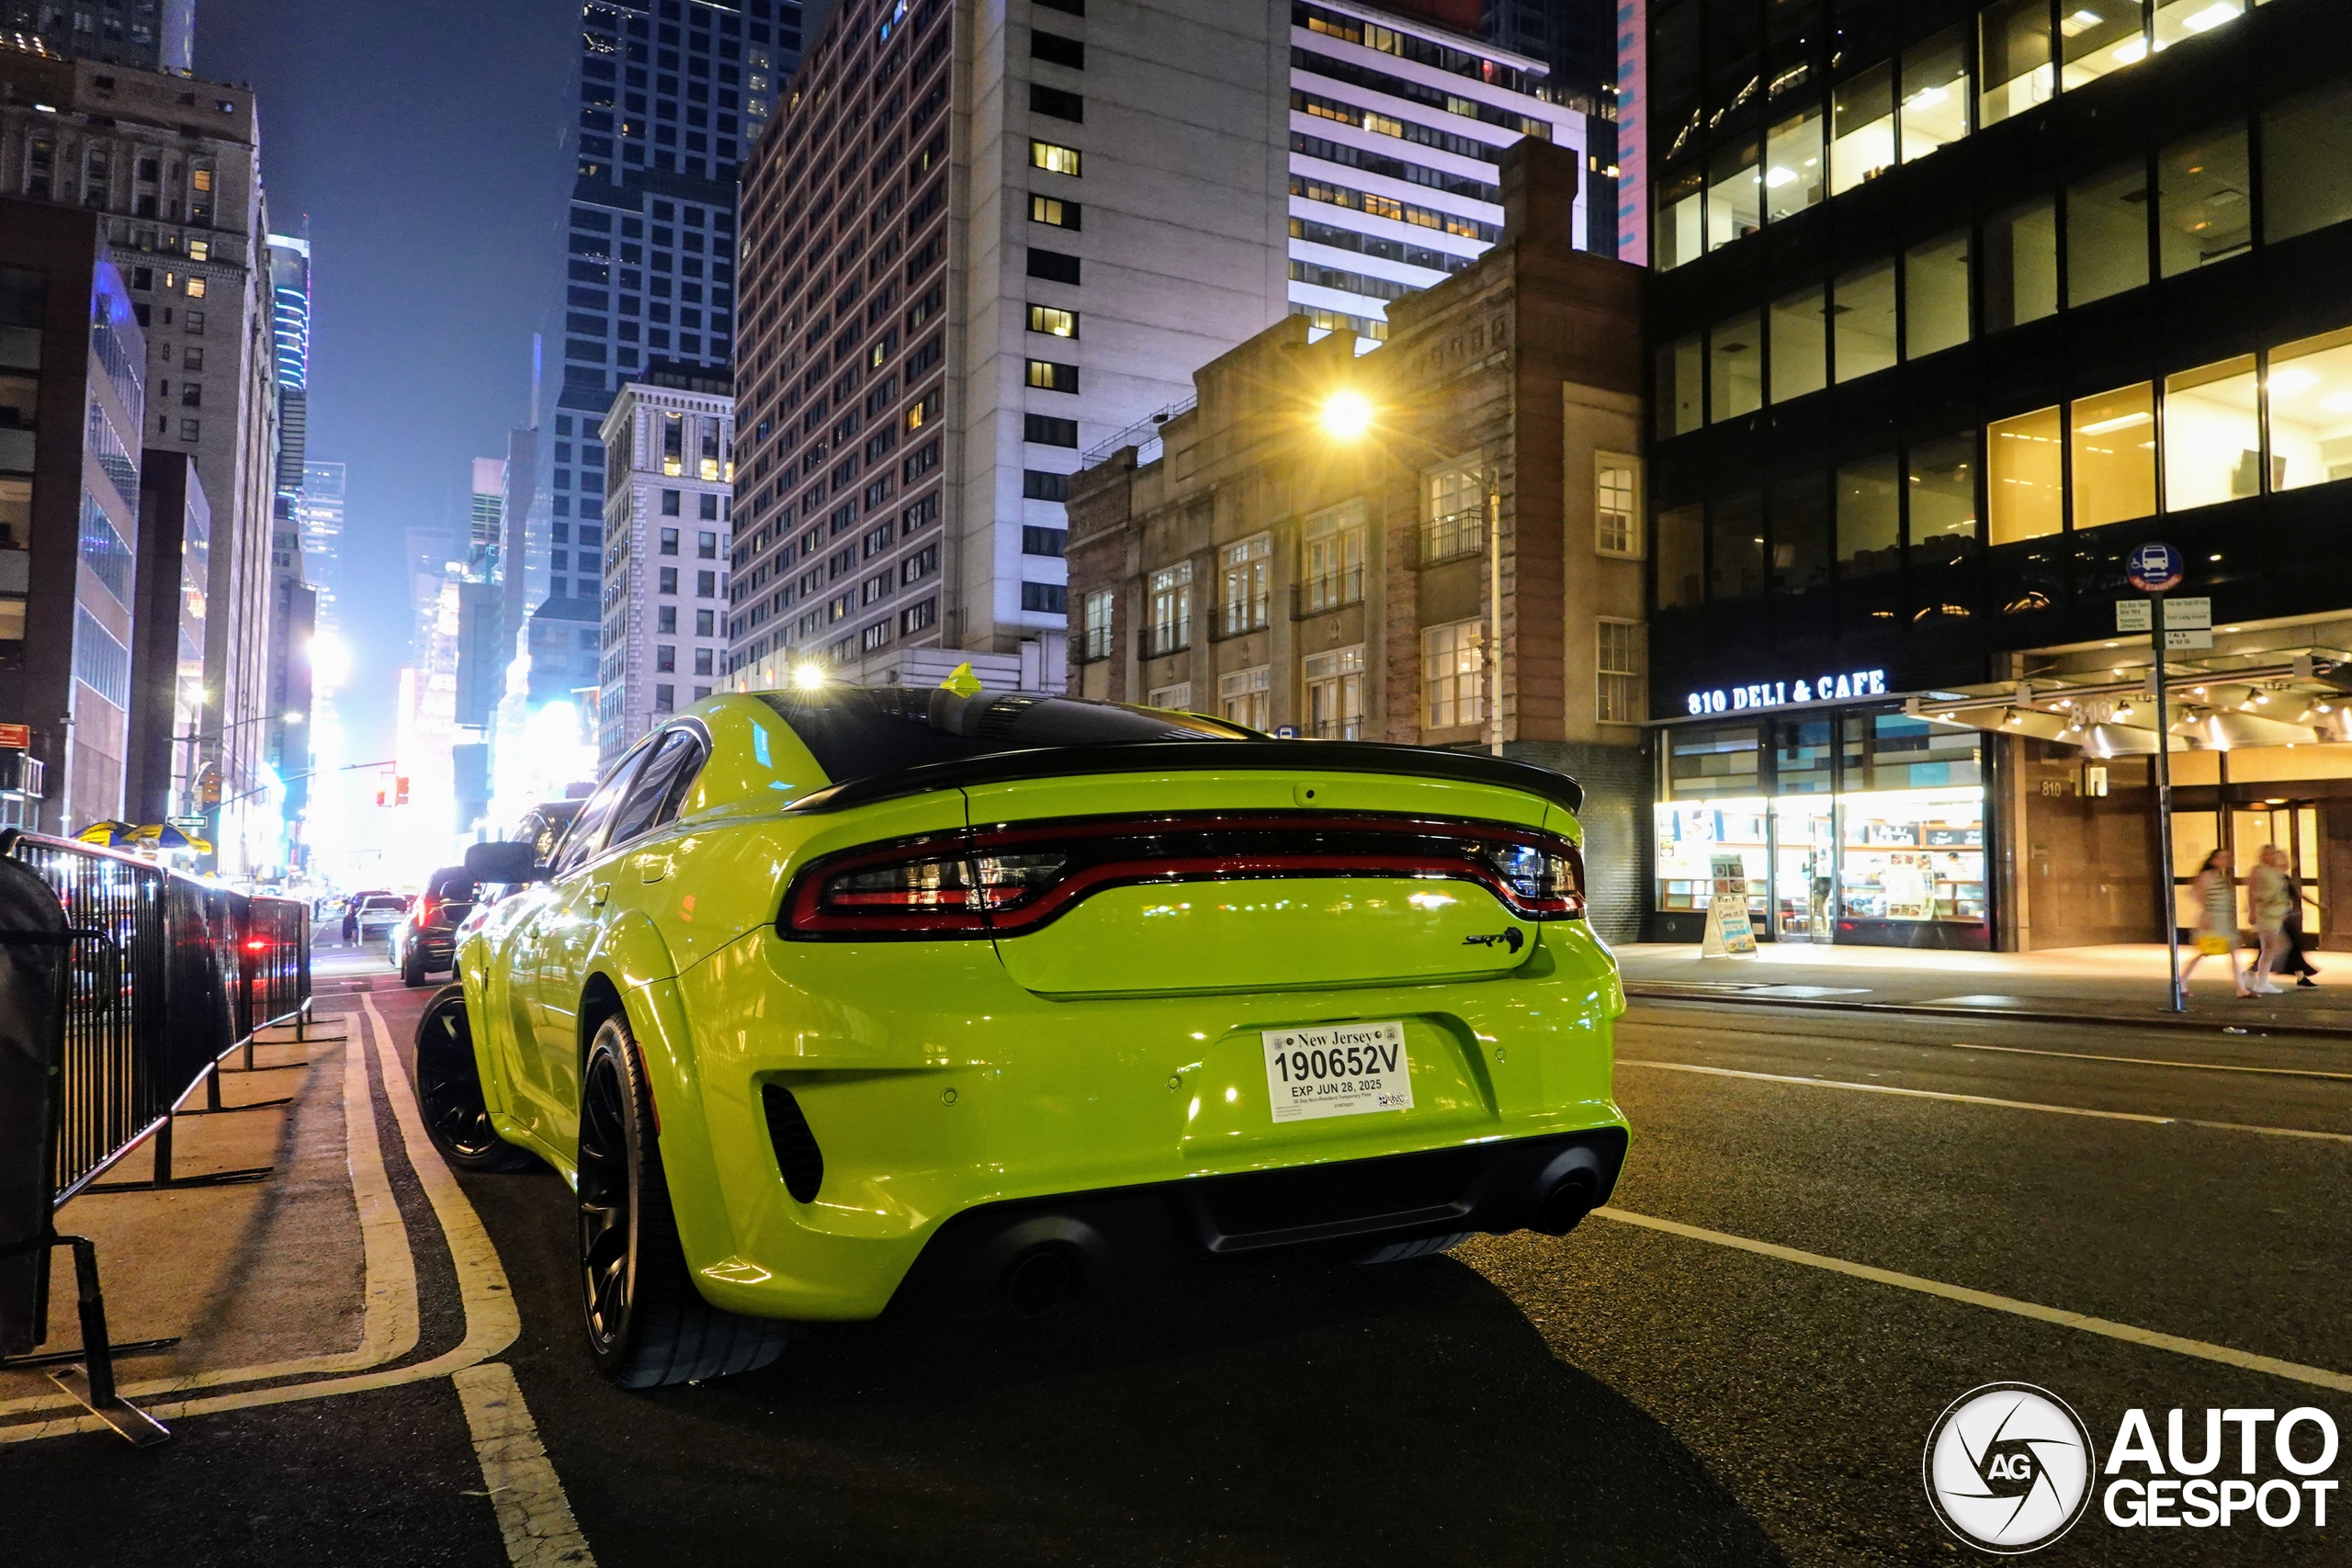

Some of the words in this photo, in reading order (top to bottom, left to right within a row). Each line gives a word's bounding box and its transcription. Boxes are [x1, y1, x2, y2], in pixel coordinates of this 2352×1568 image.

[1688, 690, 1726, 715] 810
[1733, 682, 1785, 710] DELI
[1792, 680, 1811, 702] &
[1817, 669, 1885, 700] CAFE
[2072, 702, 2111, 725] 810
[2041, 781, 2062, 797] 810
[1297, 1033, 1328, 1047] New
[1332, 1031, 1373, 1047] Jersey
[1274, 1043, 1398, 1082] 190652V
[1292, 1086, 1313, 1098] EXP
[1317, 1083, 1339, 1095] JUN
[1341, 1081, 1357, 1093] 28,
[1359, 1079, 1382, 1091] 2025
